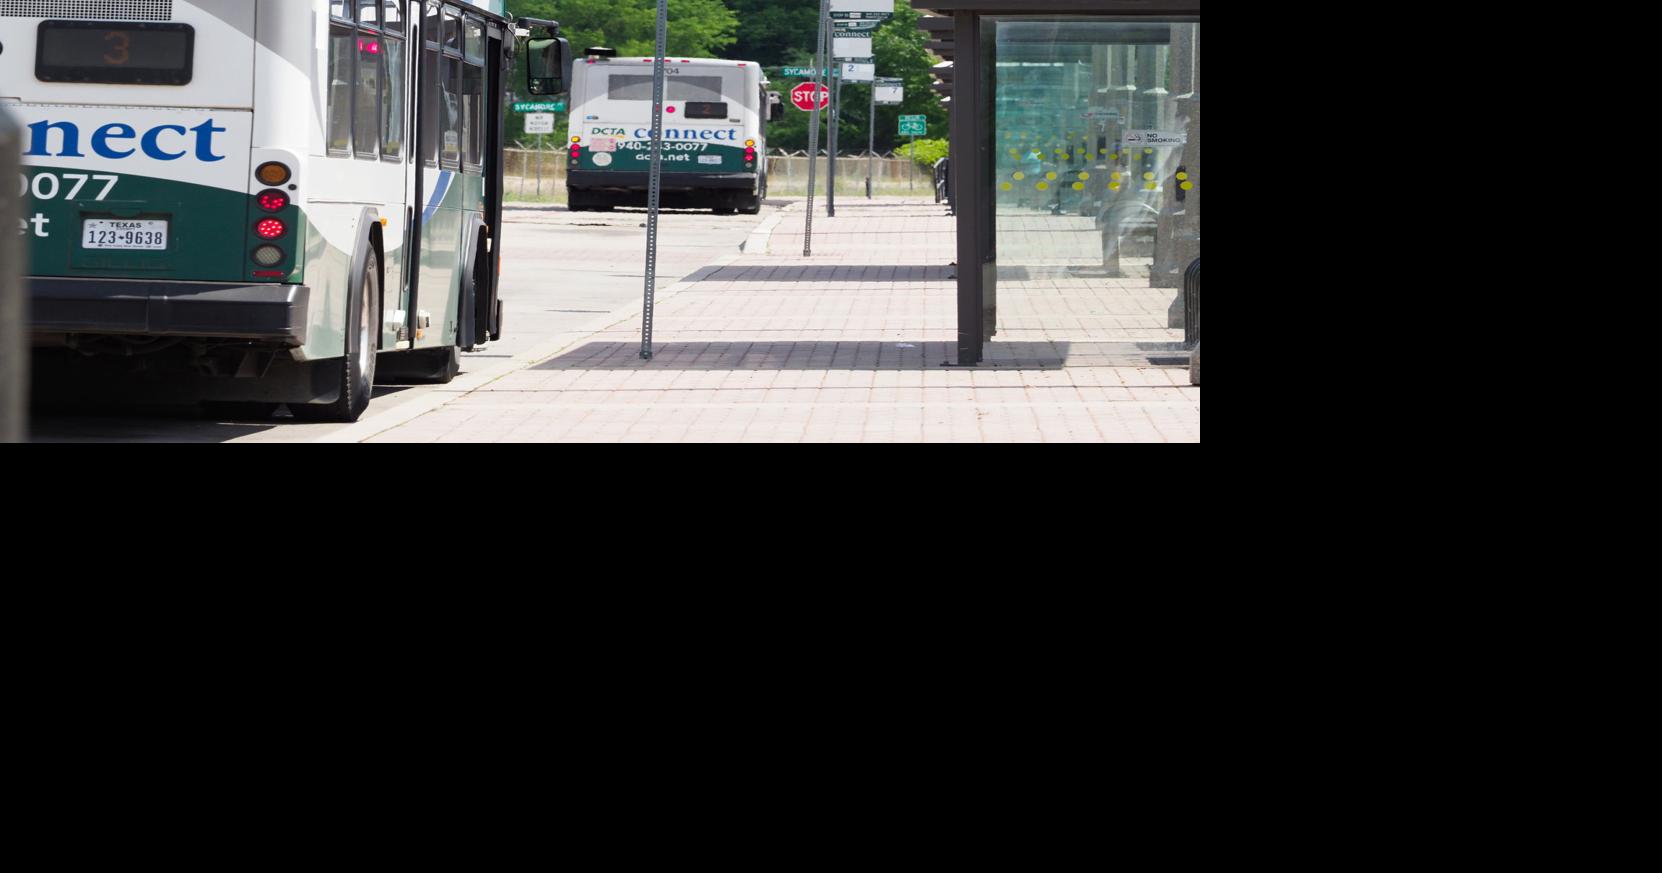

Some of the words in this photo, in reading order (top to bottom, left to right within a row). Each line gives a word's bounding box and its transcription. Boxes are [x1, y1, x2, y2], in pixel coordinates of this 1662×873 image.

[103, 31, 130, 65] 3
[783, 67, 828, 77] SYCAMOE
[848, 64, 855, 72] 2
[591, 127, 626, 136] DCTA
[23, 118, 227, 163] nect
[616, 141, 709, 152] 940-23-0077
[109, 221, 142, 229] TEXAS
